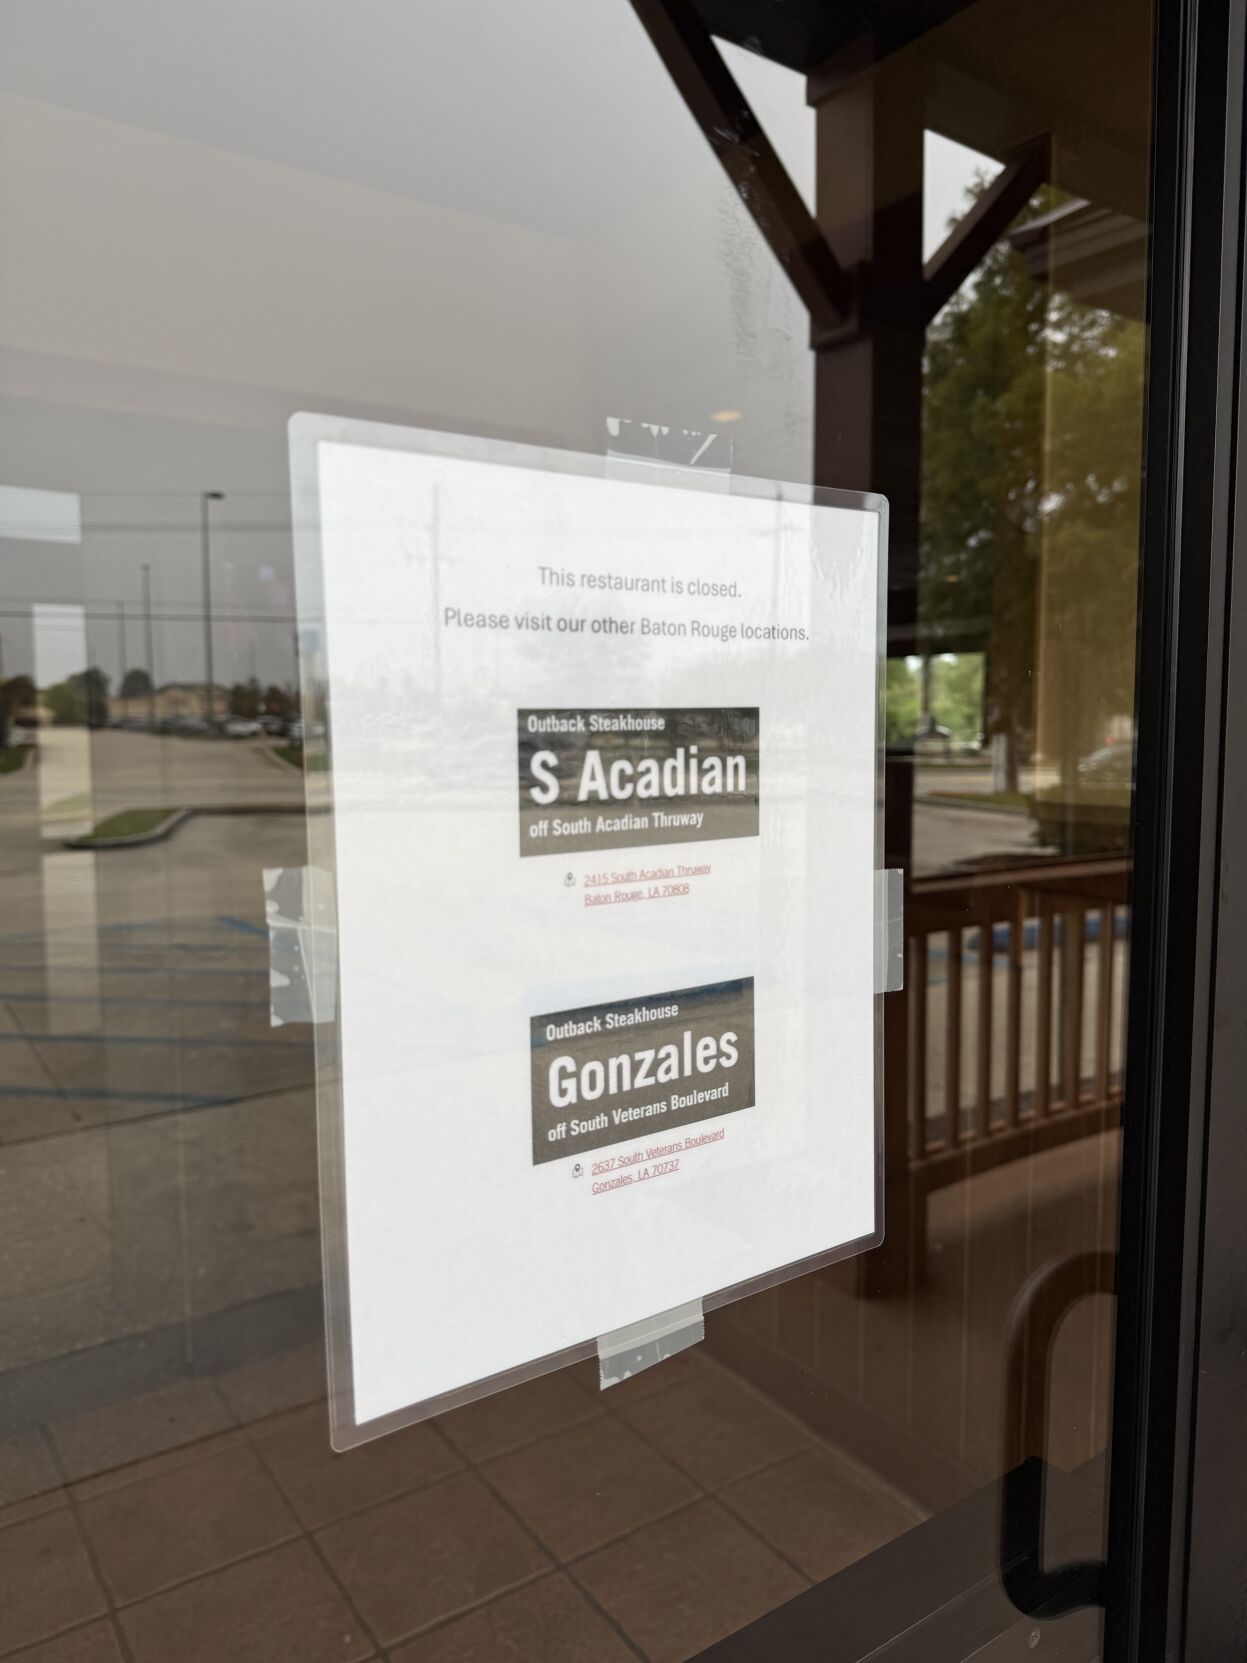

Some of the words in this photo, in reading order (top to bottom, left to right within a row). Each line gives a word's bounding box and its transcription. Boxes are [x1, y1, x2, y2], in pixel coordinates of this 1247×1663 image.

[538, 566, 575, 587] This
[580, 574, 666, 593] restaurant
[671, 578, 683, 594] is
[688, 580, 742, 598] closed.
[444, 607, 510, 630] Please
[514, 611, 552, 632] visit
[557, 617, 586, 633] our
[591, 617, 635, 635] other
[640, 620, 686, 637] Baton
[691, 622, 737, 642] Rouge
[741, 623, 809, 641] locations.
[528, 715, 586, 732] Outback
[589, 714, 665, 732] Steakhouse
[529, 750, 560, 805] S
[577, 745, 746, 801] Acadian
[530, 820, 548, 838] off
[553, 817, 591, 836] South
[596, 814, 649, 833] Acadian
[652, 812, 704, 830] Thruway
[584, 873, 609, 886] 2415
[611, 871, 637, 883] South
[640, 867, 674, 882] Acadian
[677, 863, 711, 879] Thruway
[648, 886, 660, 899] LA
[662, 883, 689, 897] 70808
[546, 1016, 601, 1041] Outback
[606, 1004, 679, 1029] Steakhouse
[548, 1030, 739, 1108] Gonzales
[548, 1123, 567, 1142] off
[570, 1113, 608, 1136] South
[612, 1100, 667, 1125] Veterans
[671, 1082, 729, 1110] Boulevard
[592, 1158, 615, 1175] 2637
[618, 1150, 643, 1168] South
[645, 1140, 683, 1161] Veterans
[685, 1128, 725, 1150] Boulevard
[638, 1166, 649, 1181] LA
[652, 1159, 680, 1178] 70737
